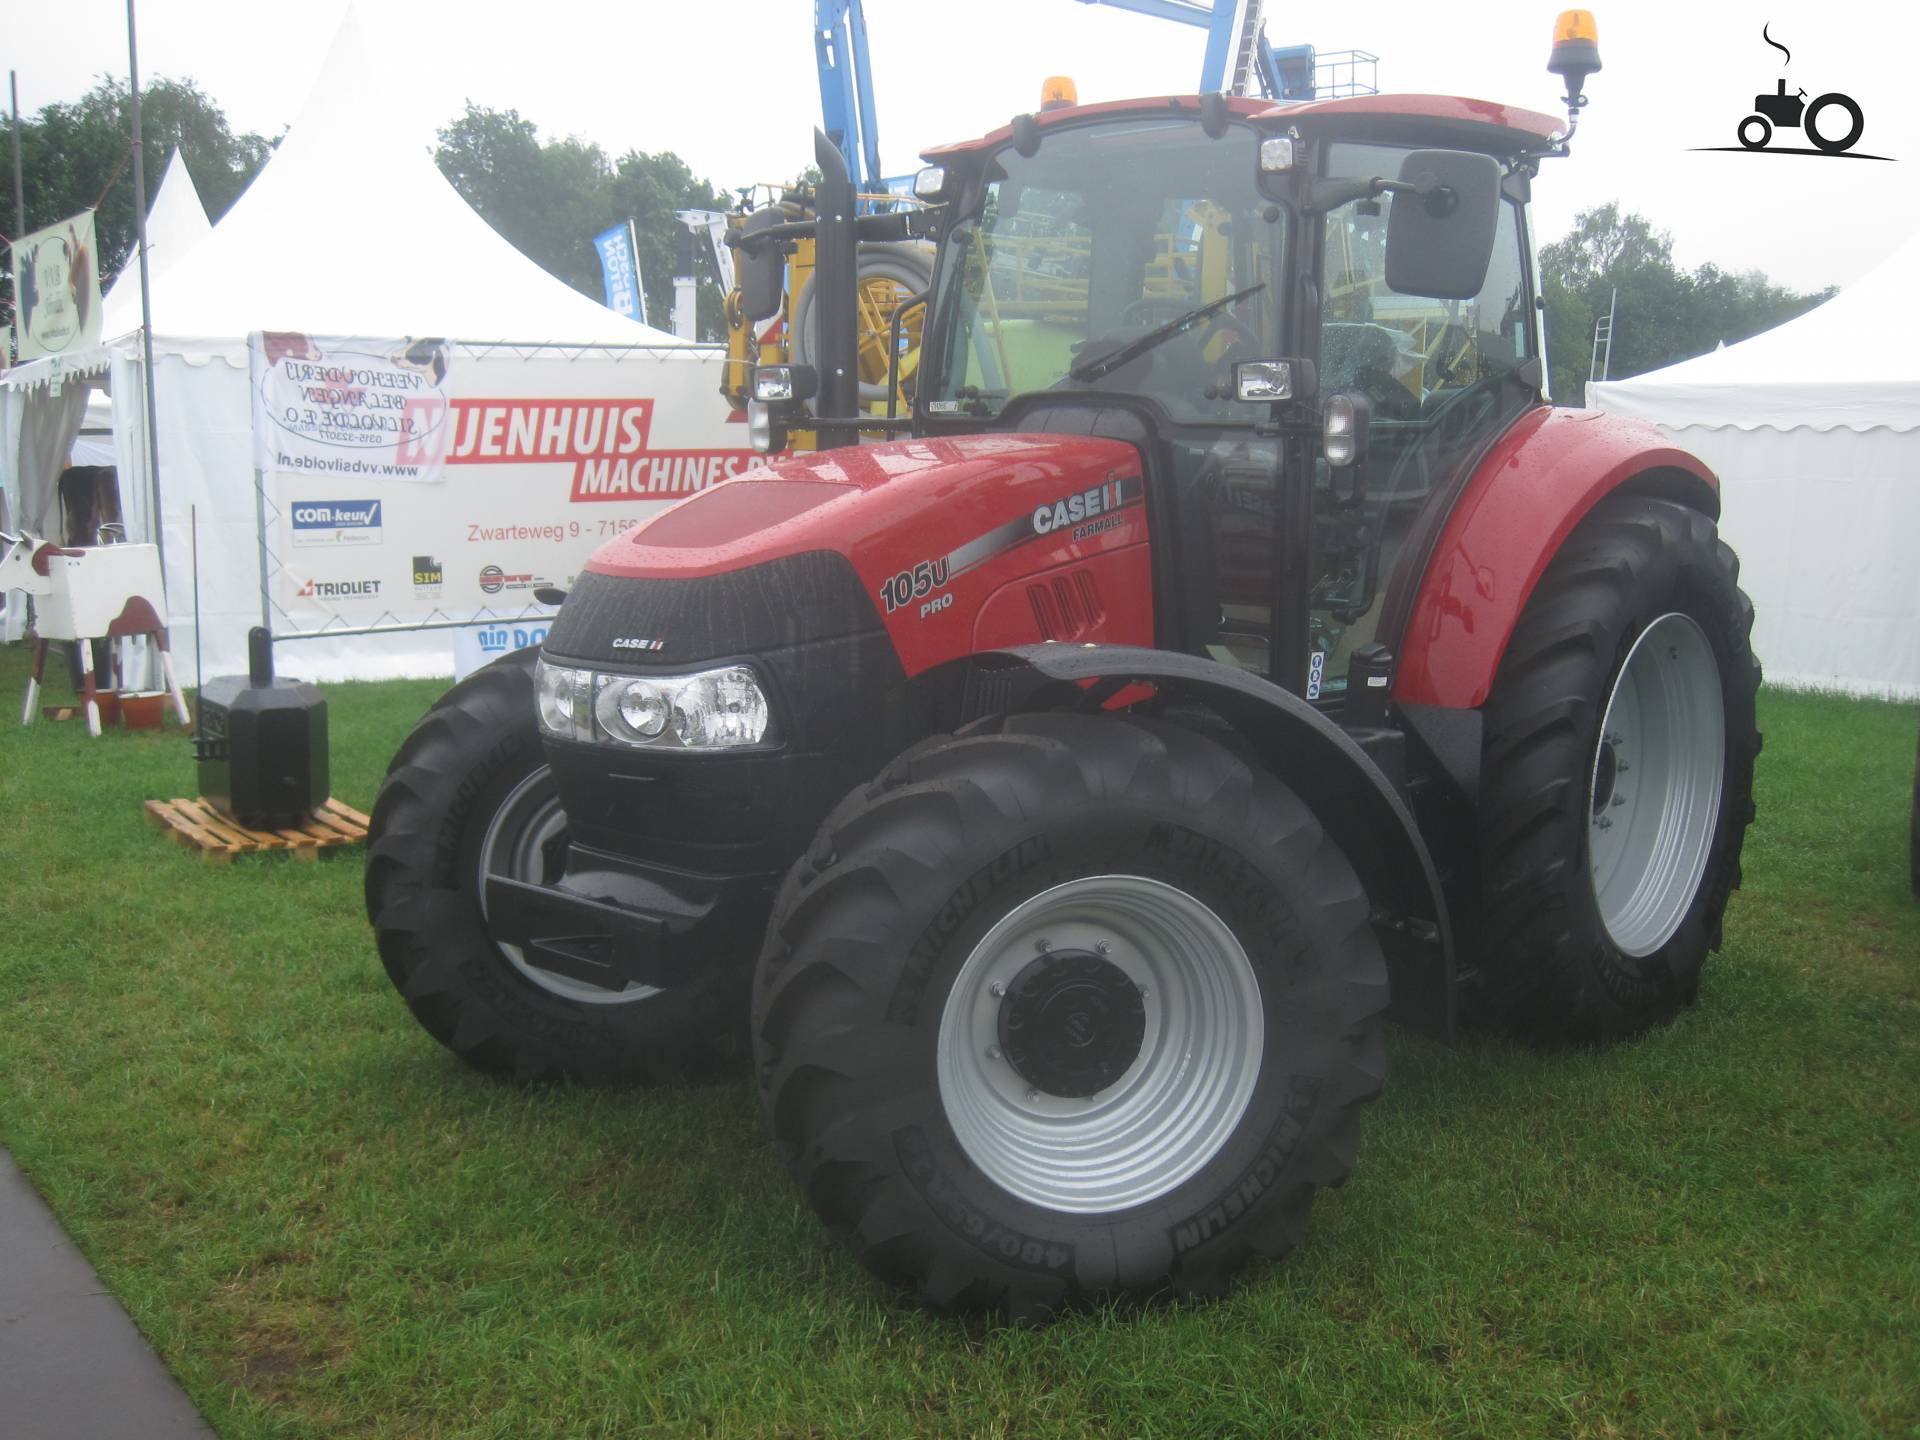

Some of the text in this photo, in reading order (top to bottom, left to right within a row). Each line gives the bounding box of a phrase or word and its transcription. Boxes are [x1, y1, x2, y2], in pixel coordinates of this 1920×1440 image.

[579, 456, 738, 495] MACHINES
[1033, 487, 1103, 534] CASE
[467, 522, 564, 543] Zwarteweg
[569, 521, 580, 538] 9
[1072, 512, 1123, 541] FARMALL
[314, 580, 381, 596] TRIOLIET
[414, 572, 441, 583] SIM
[880, 555, 950, 614] 105U
[920, 593, 953, 619] PRO
[612, 637, 649, 649] CASE
[1174, 1111, 1303, 1254] MICHELIN
